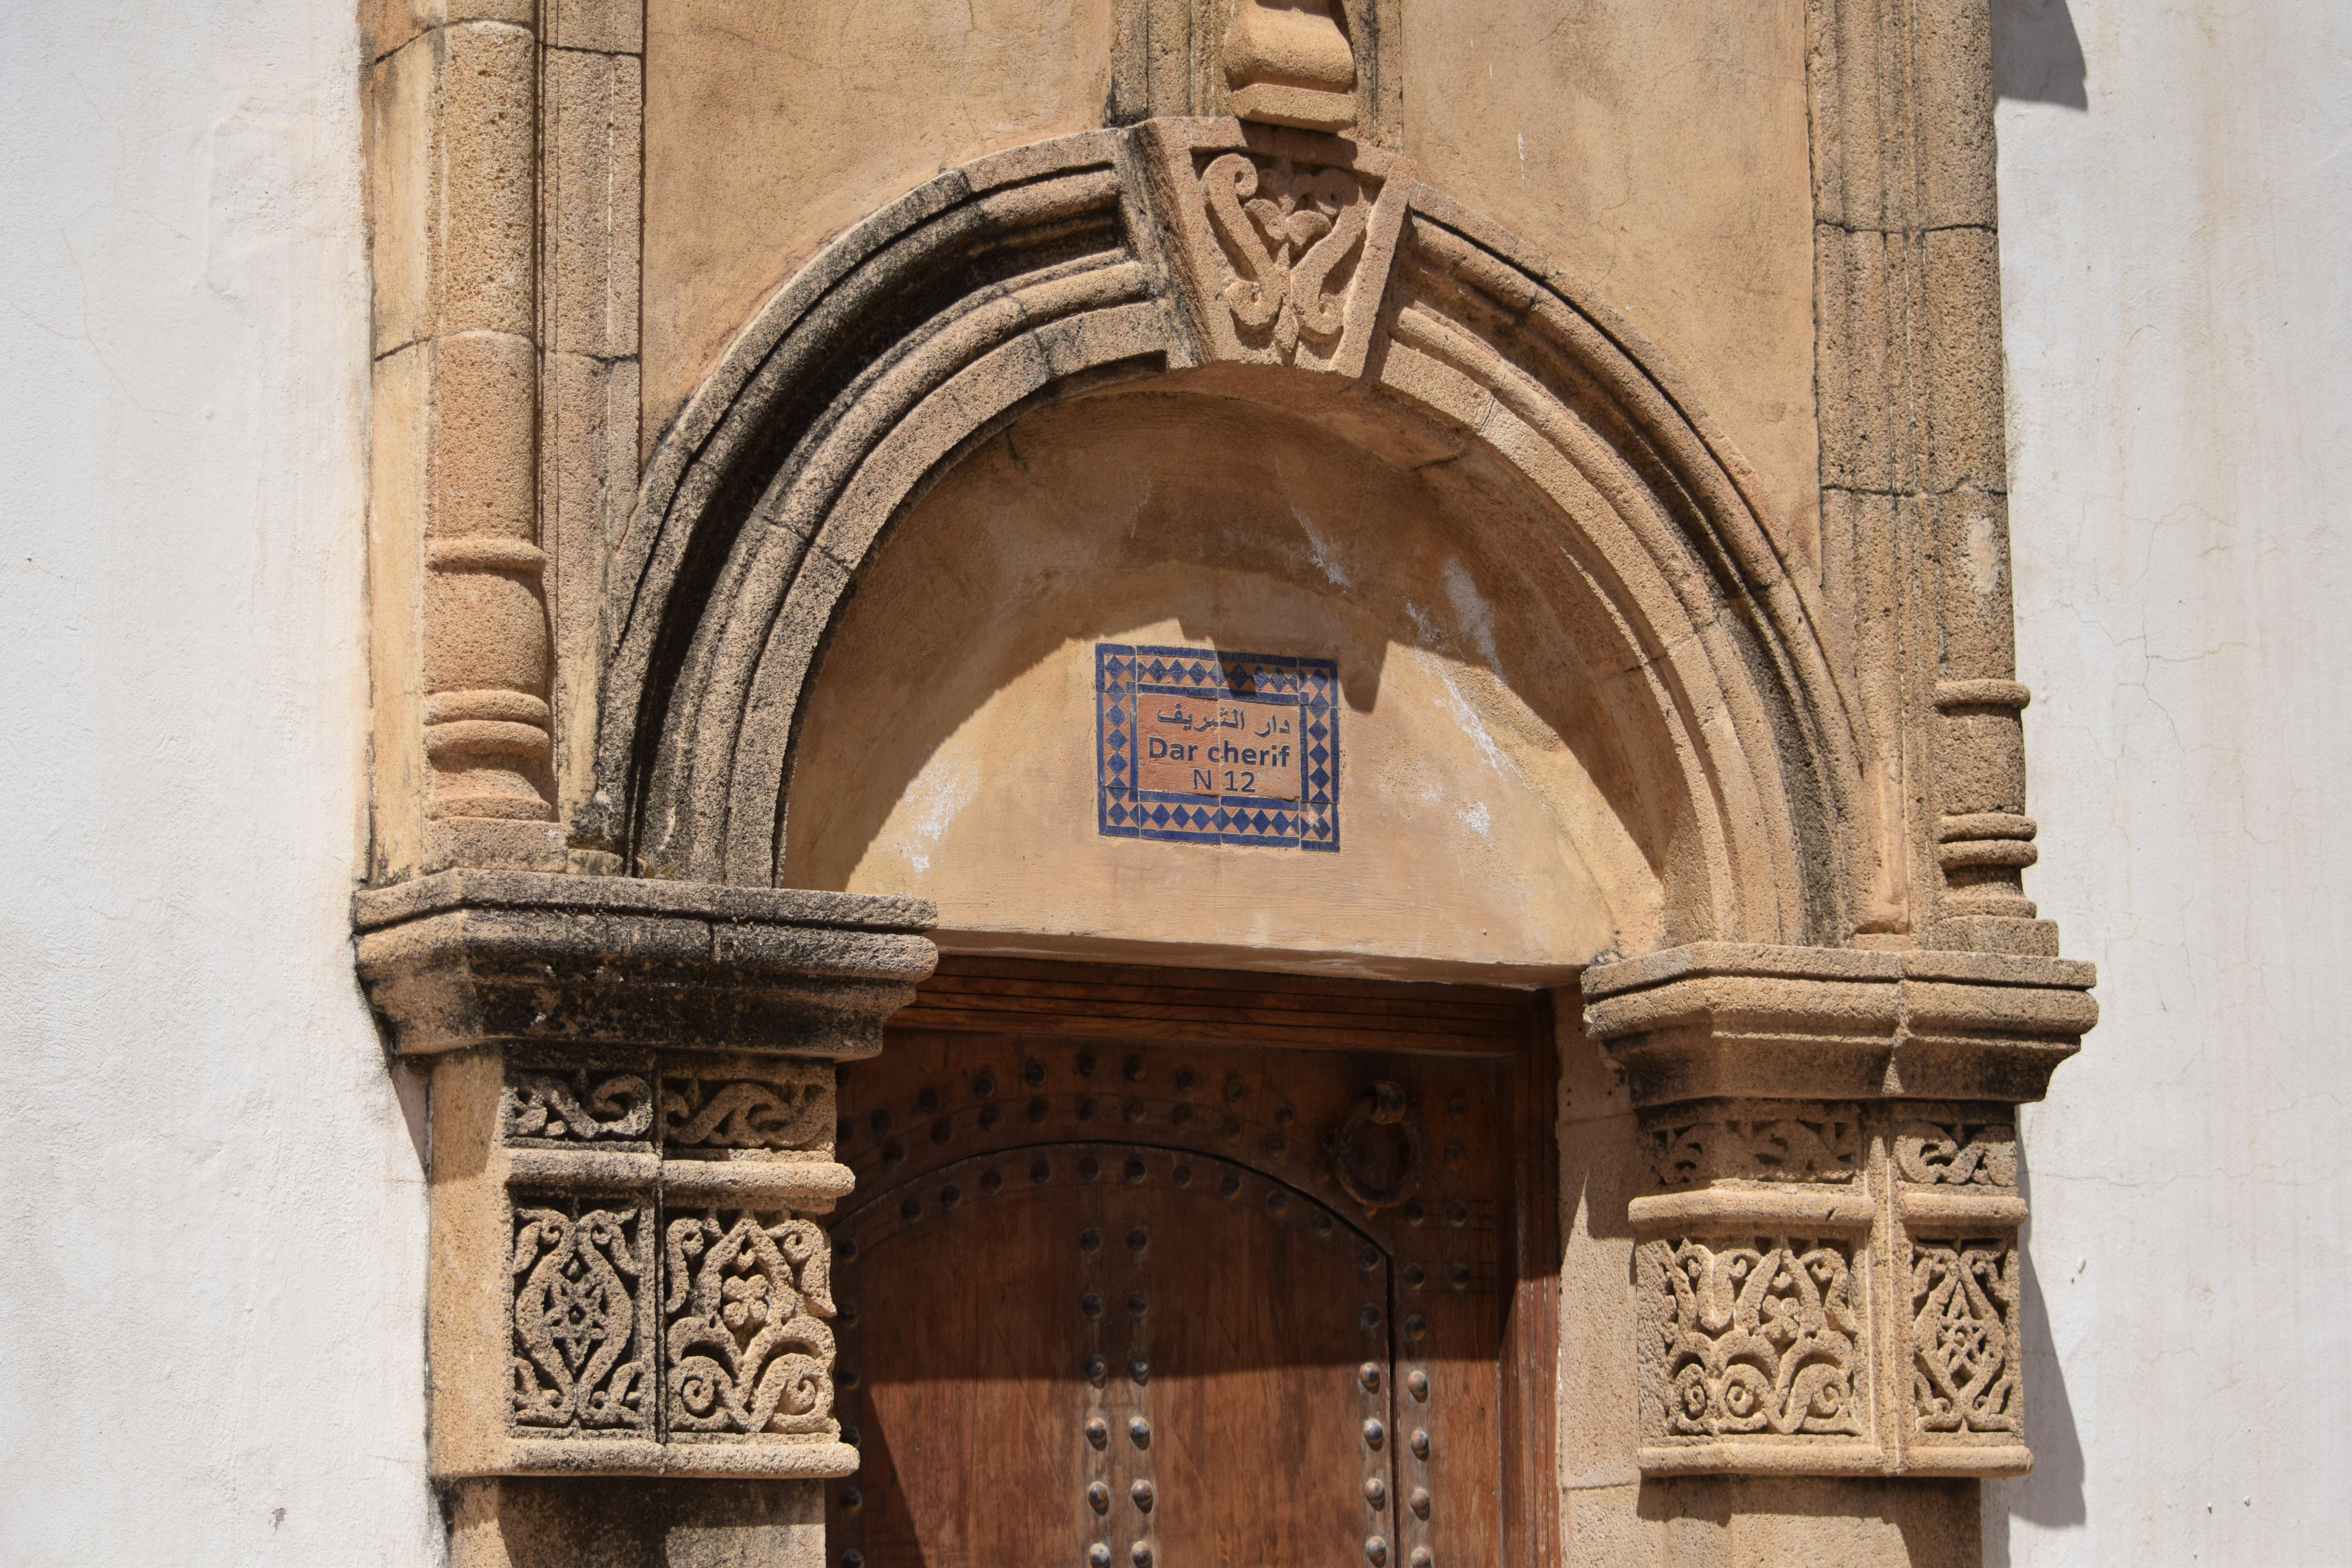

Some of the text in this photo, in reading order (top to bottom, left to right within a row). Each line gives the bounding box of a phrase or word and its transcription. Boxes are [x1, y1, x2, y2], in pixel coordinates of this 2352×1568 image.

[1156, 703, 1290, 737] دار الشريف
[1149, 736, 1290, 767] Dar cherif
[1193, 769, 1256, 793] N 12
